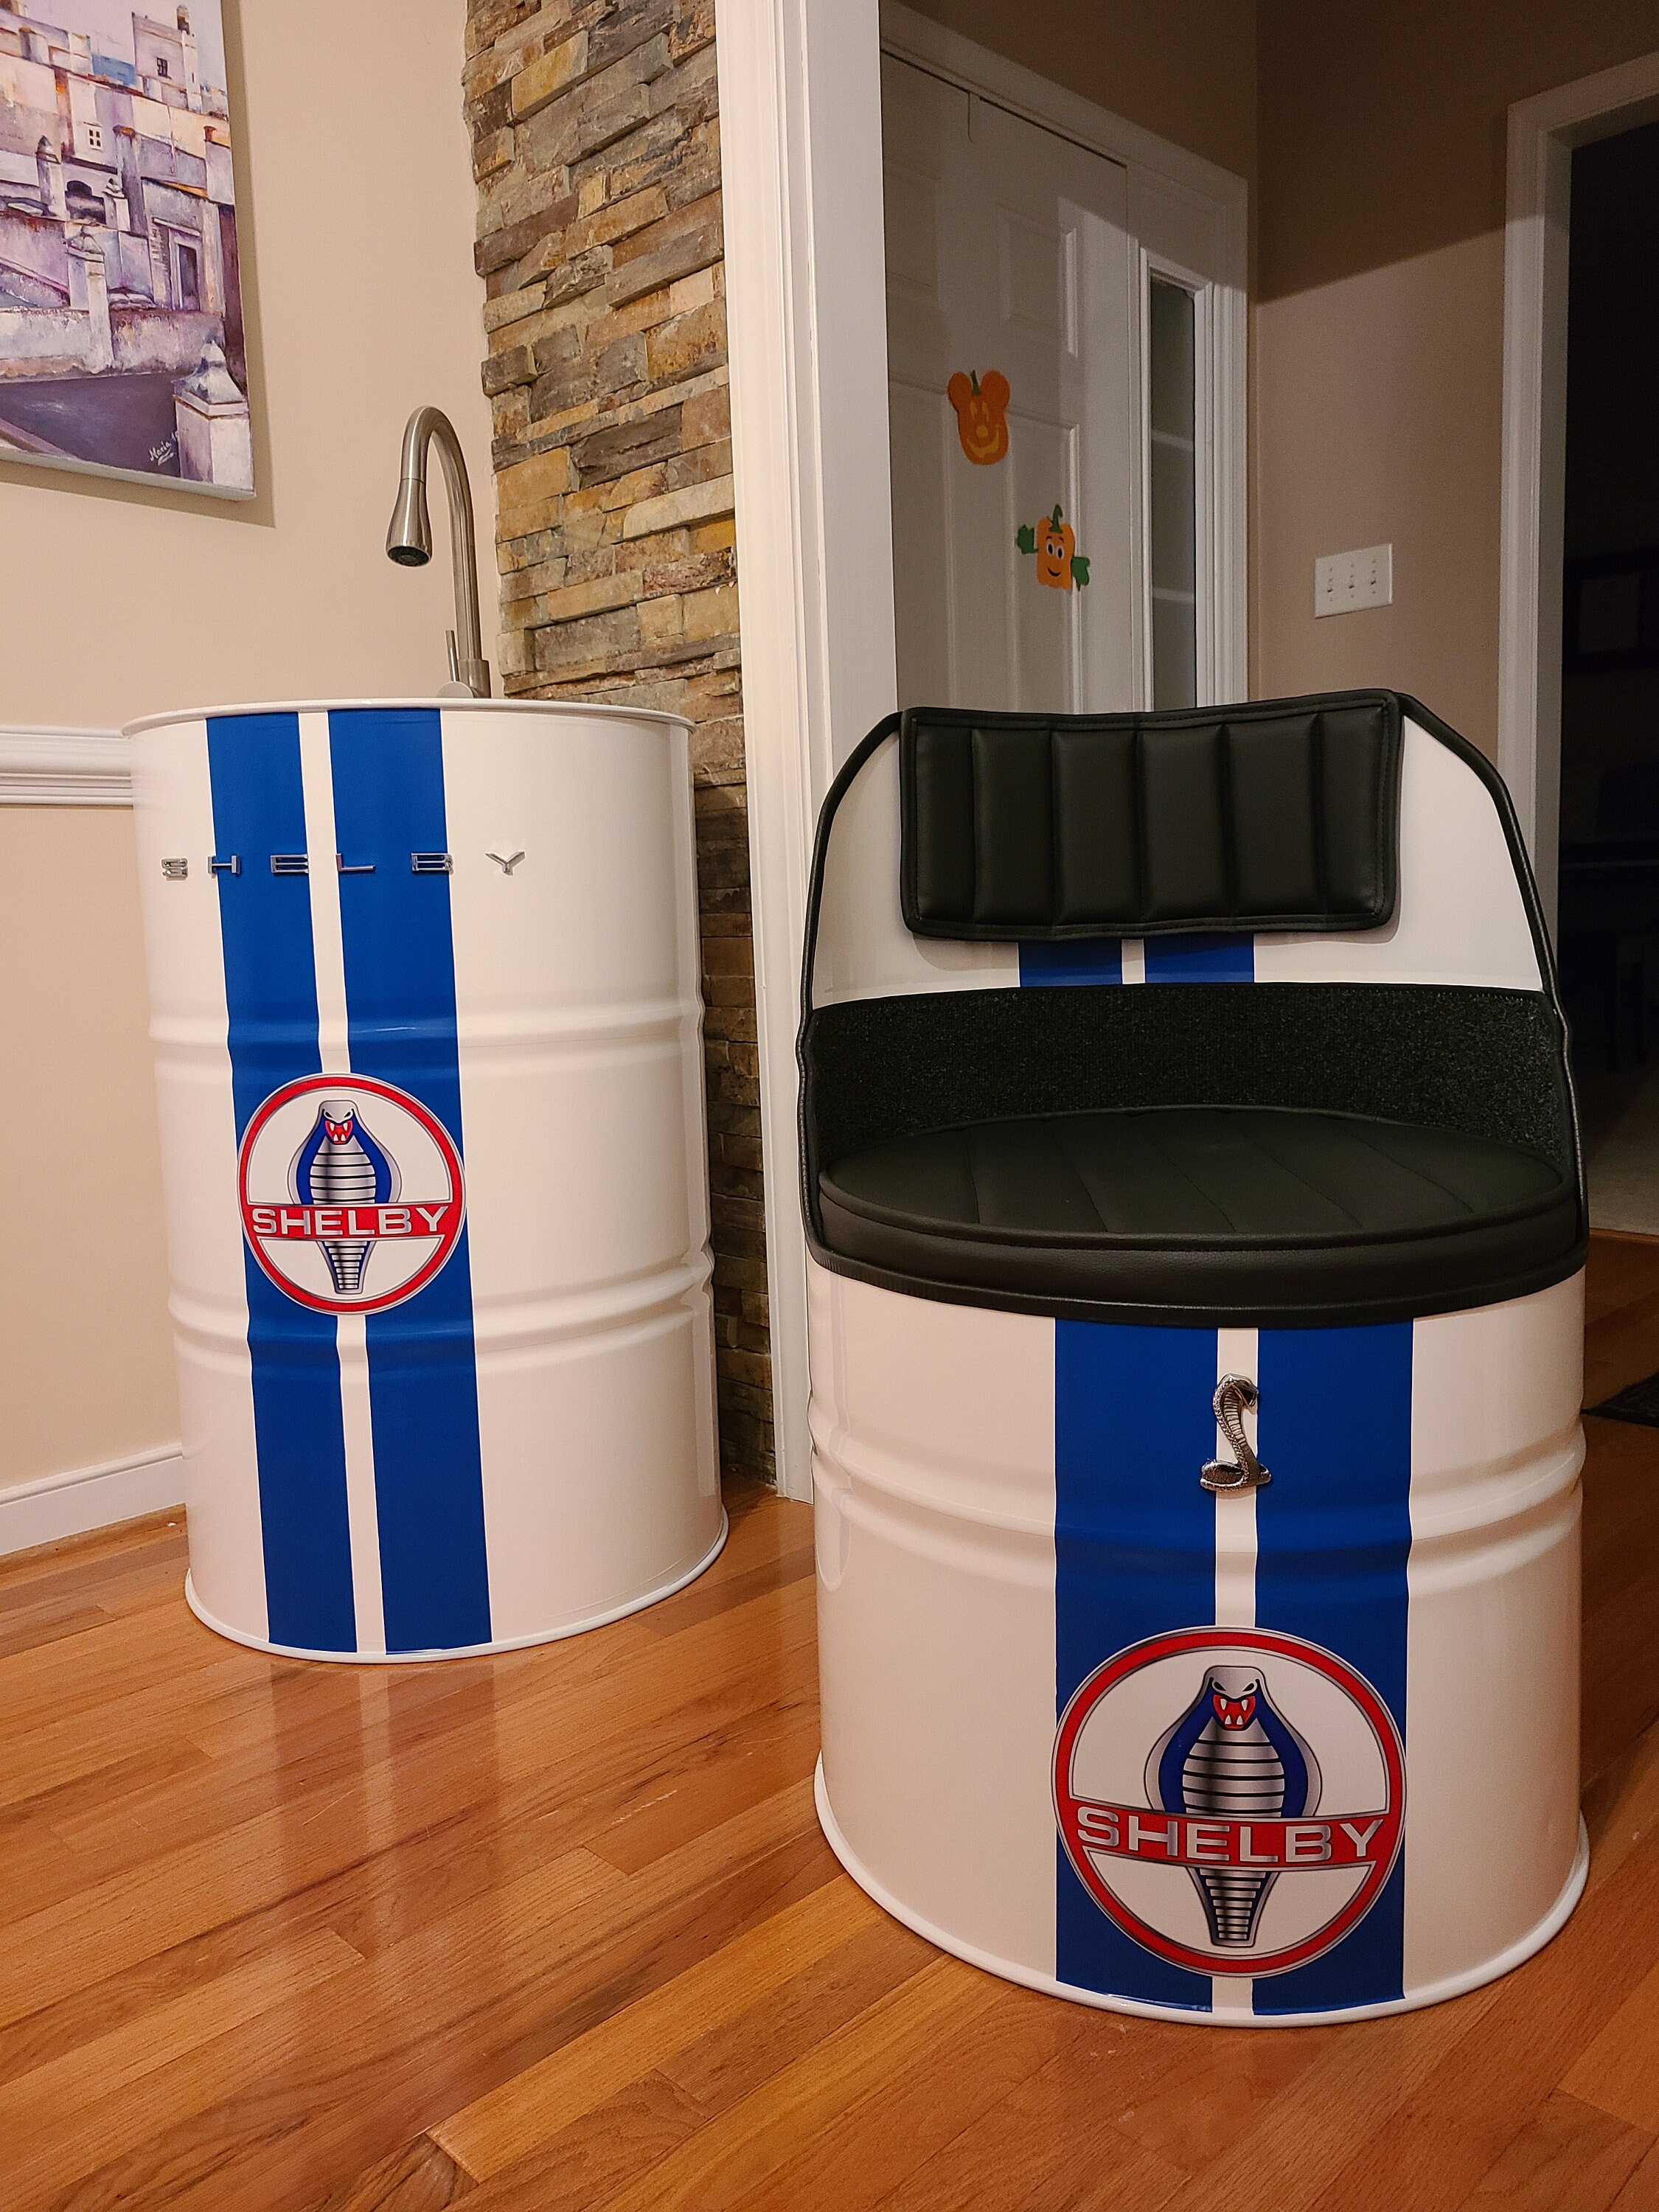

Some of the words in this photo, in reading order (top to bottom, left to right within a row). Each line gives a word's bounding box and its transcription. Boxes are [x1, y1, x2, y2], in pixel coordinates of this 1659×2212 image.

[161, 851, 525, 880] SHELBY
[252, 1206, 448, 1235] SHELBY
[1077, 1806, 1383, 1863] SHELBY
